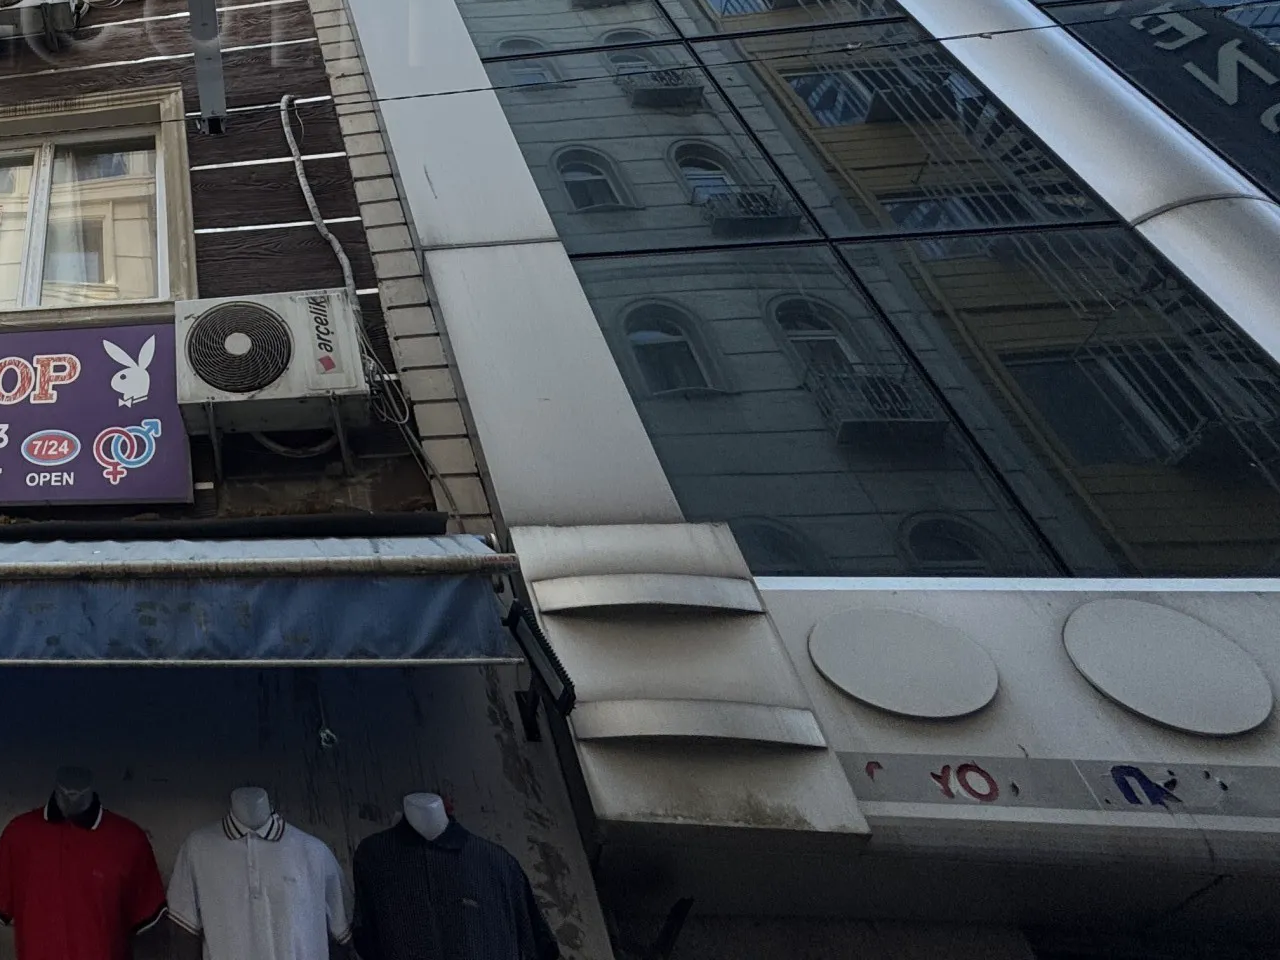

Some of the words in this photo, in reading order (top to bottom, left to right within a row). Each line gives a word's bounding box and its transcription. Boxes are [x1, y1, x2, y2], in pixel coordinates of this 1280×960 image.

[308, 295, 334, 353] arçelik
[31, 440, 70, 456] 7/24
[25, 472, 75, 487] OPEN
